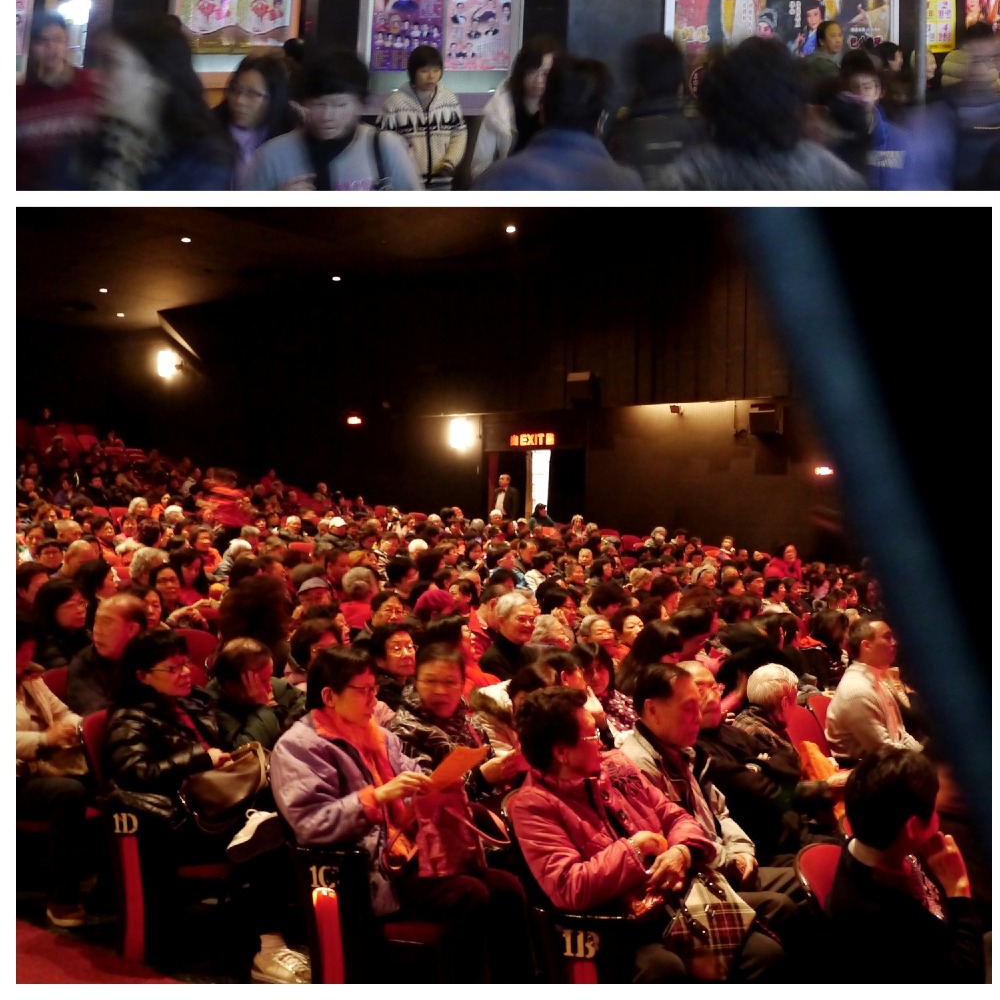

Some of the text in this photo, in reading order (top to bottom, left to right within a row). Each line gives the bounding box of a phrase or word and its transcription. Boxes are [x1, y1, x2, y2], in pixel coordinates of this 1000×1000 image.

[520, 433, 545, 446] EXIT
[113, 812, 138, 834] 1D
[562, 929, 600, 958] 1B
